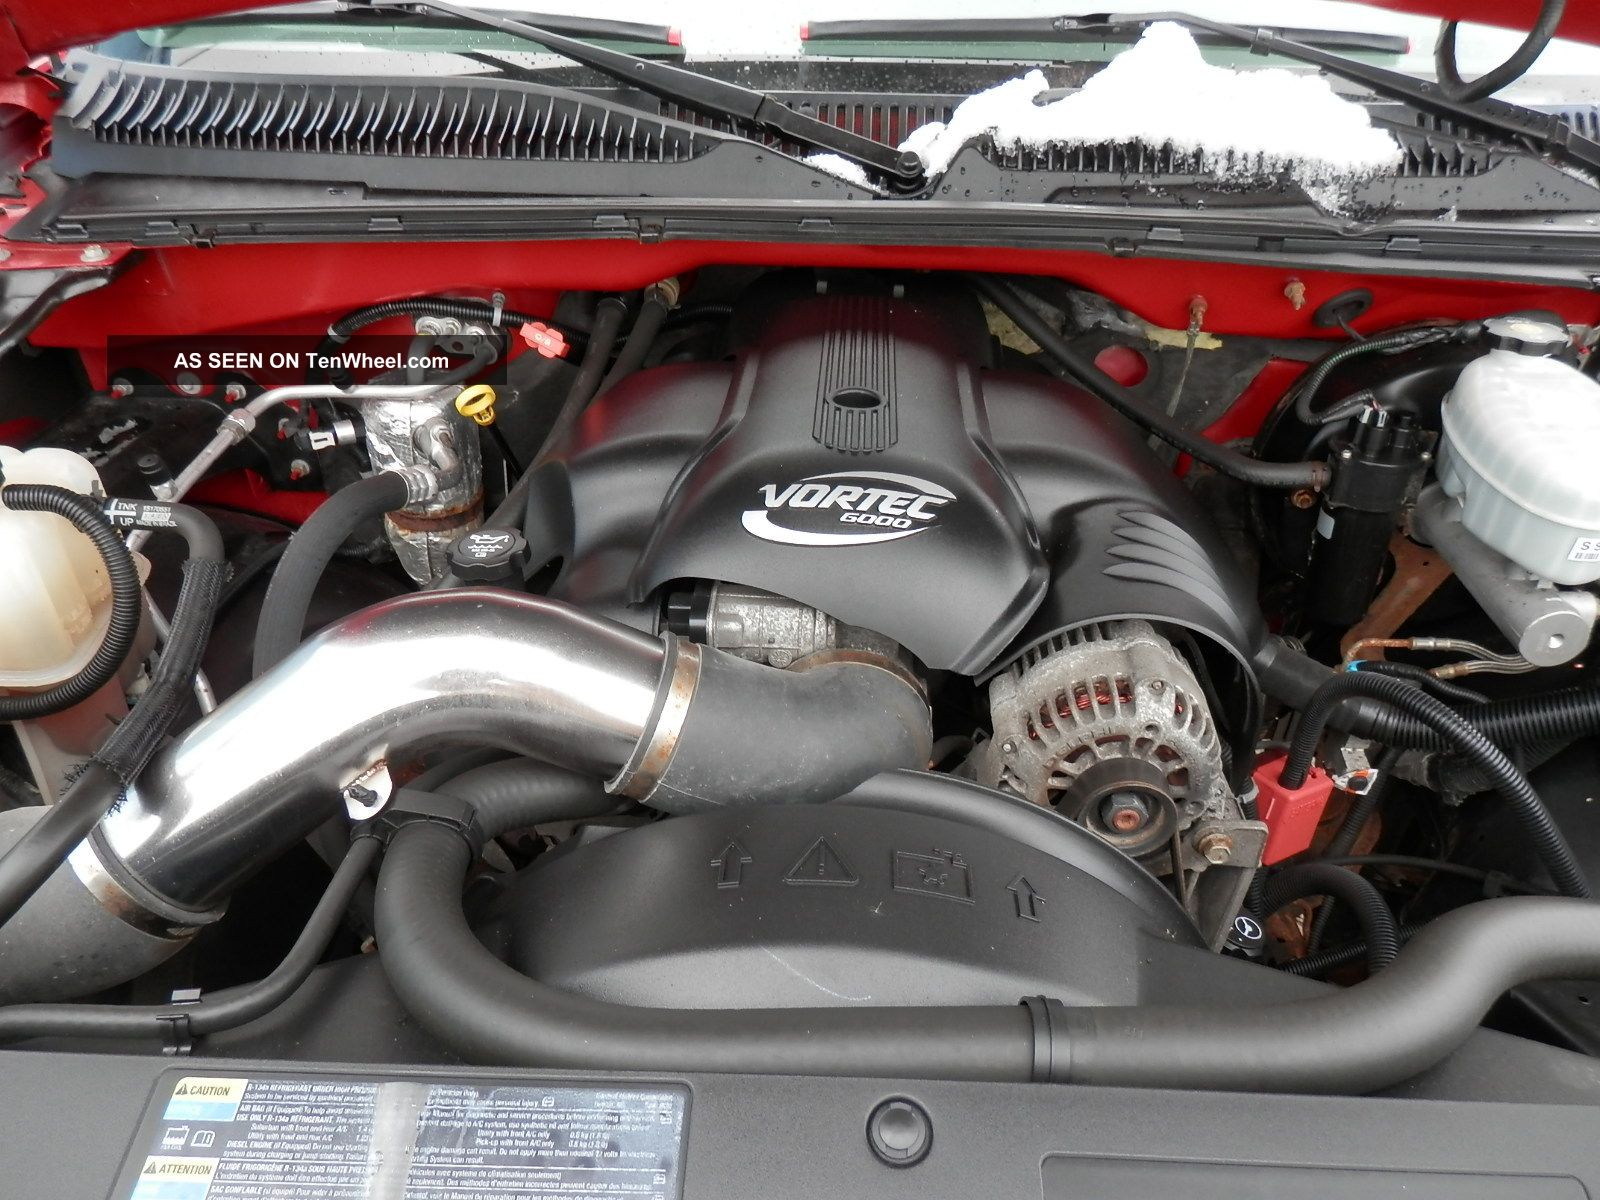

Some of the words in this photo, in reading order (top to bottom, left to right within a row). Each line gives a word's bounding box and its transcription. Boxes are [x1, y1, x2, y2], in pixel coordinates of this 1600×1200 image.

[757, 484, 950, 520] VORTEC
[120, 517, 134, 526] UP
[840, 512, 912, 529] 6000
[189, 1086, 230, 1096] CAUTION
[159, 1164, 212, 1175] ATTENTION
